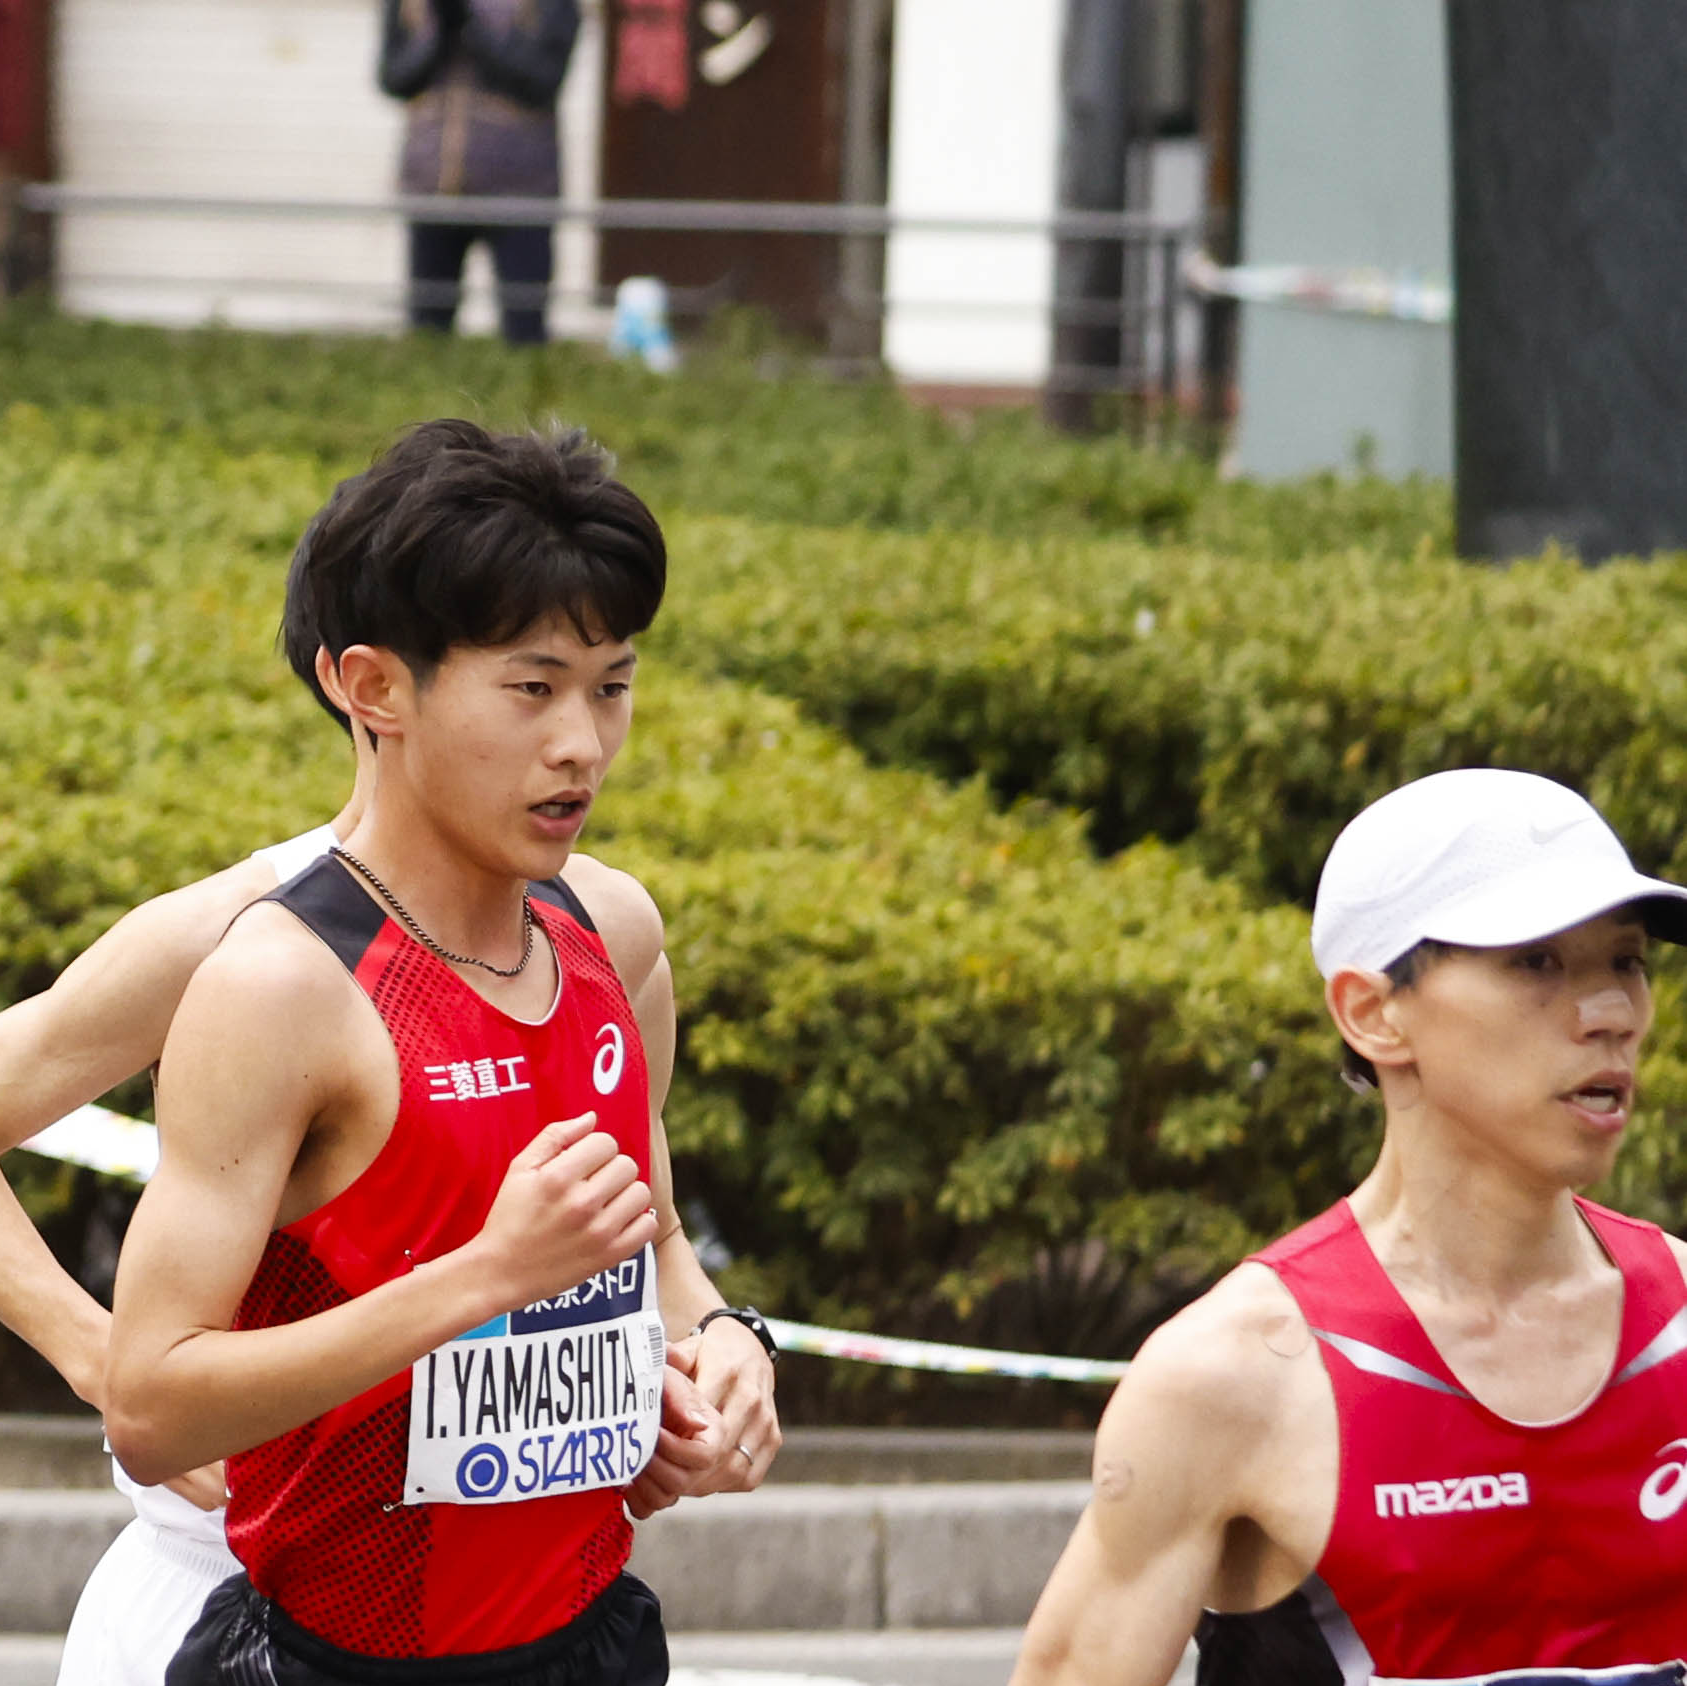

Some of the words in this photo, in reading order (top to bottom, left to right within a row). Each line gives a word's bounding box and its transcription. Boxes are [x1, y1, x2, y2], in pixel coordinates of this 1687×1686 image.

[424, 1056, 532, 1101] 三菱重工
[514, 1419, 643, 1495] STARTS
[1374, 1472, 1531, 1518] mazda
